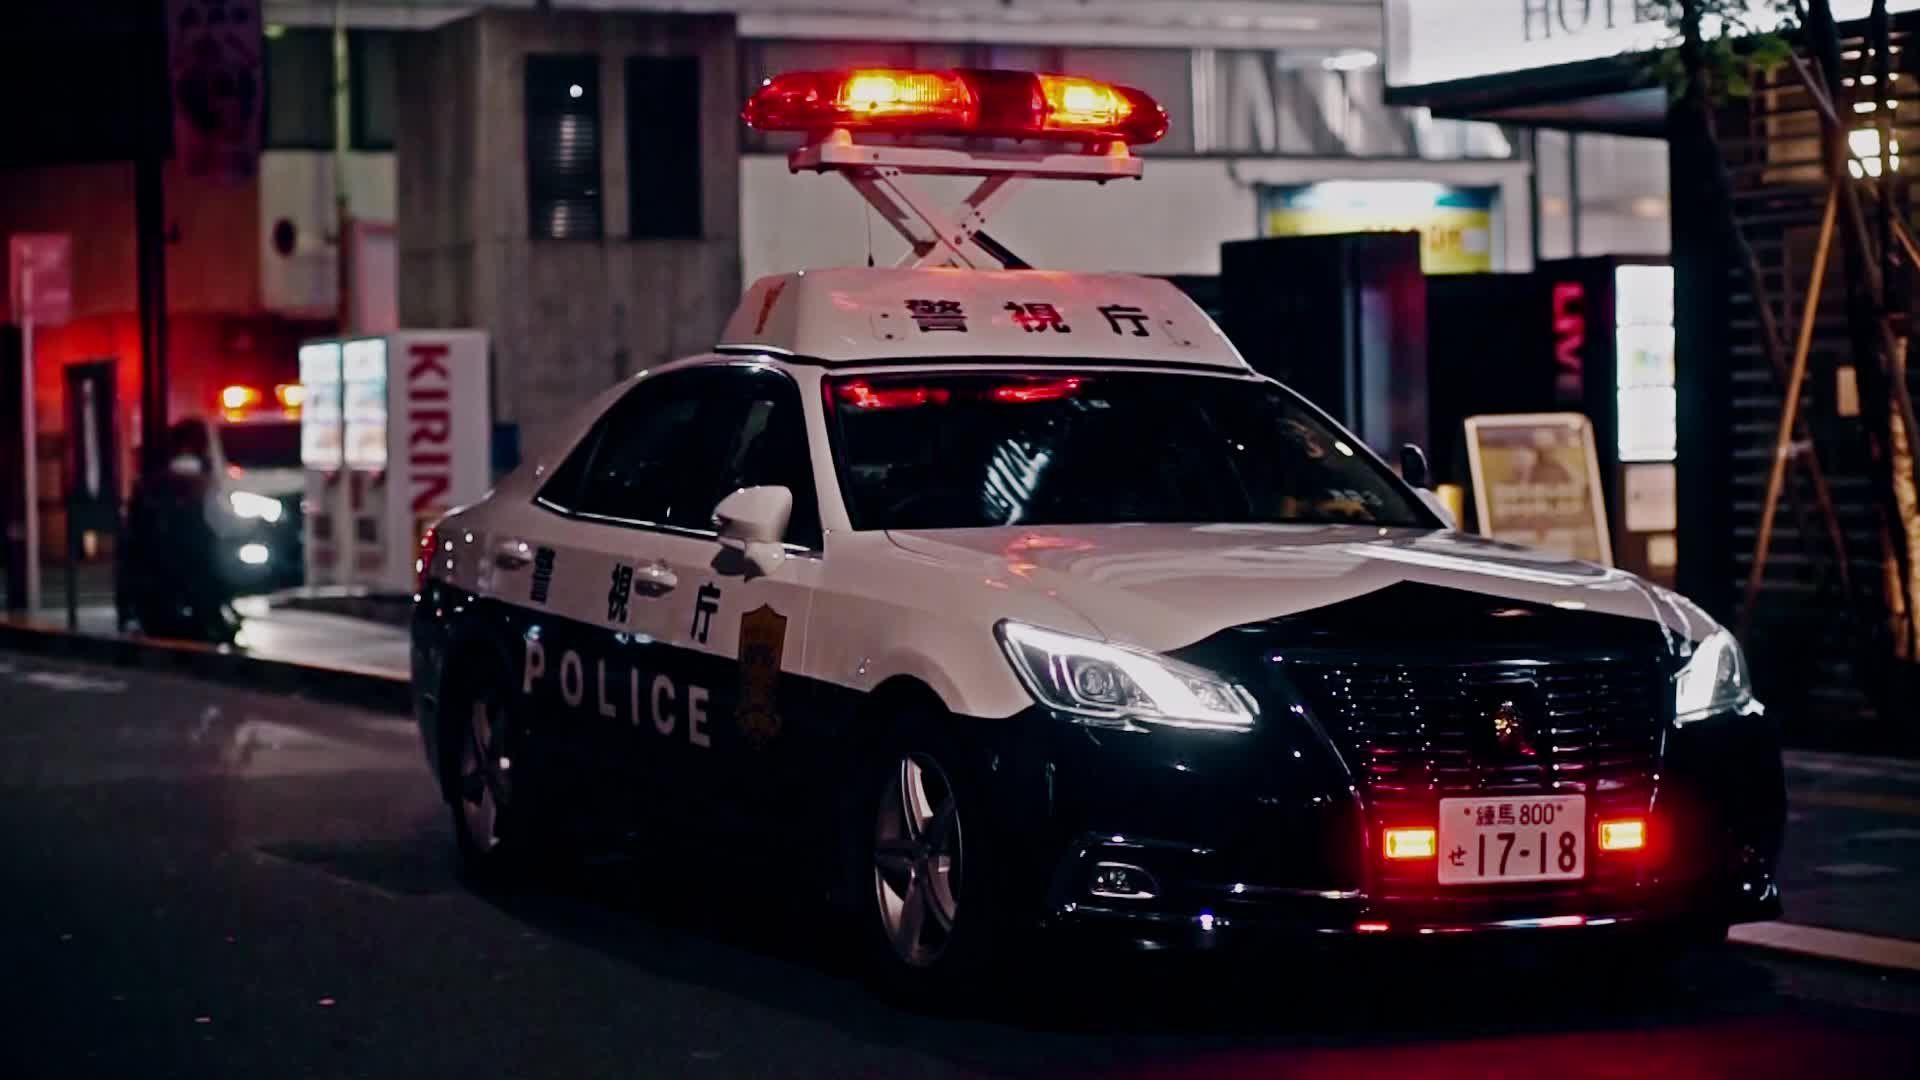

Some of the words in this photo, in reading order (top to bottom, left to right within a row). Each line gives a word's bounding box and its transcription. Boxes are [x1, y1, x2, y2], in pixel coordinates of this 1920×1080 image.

[904, 299, 1155, 337] 警視庁
[408, 344, 450, 513] KIRIN
[522, 638, 712, 748] POLICE
[1477, 831, 1577, 877] 17-18
